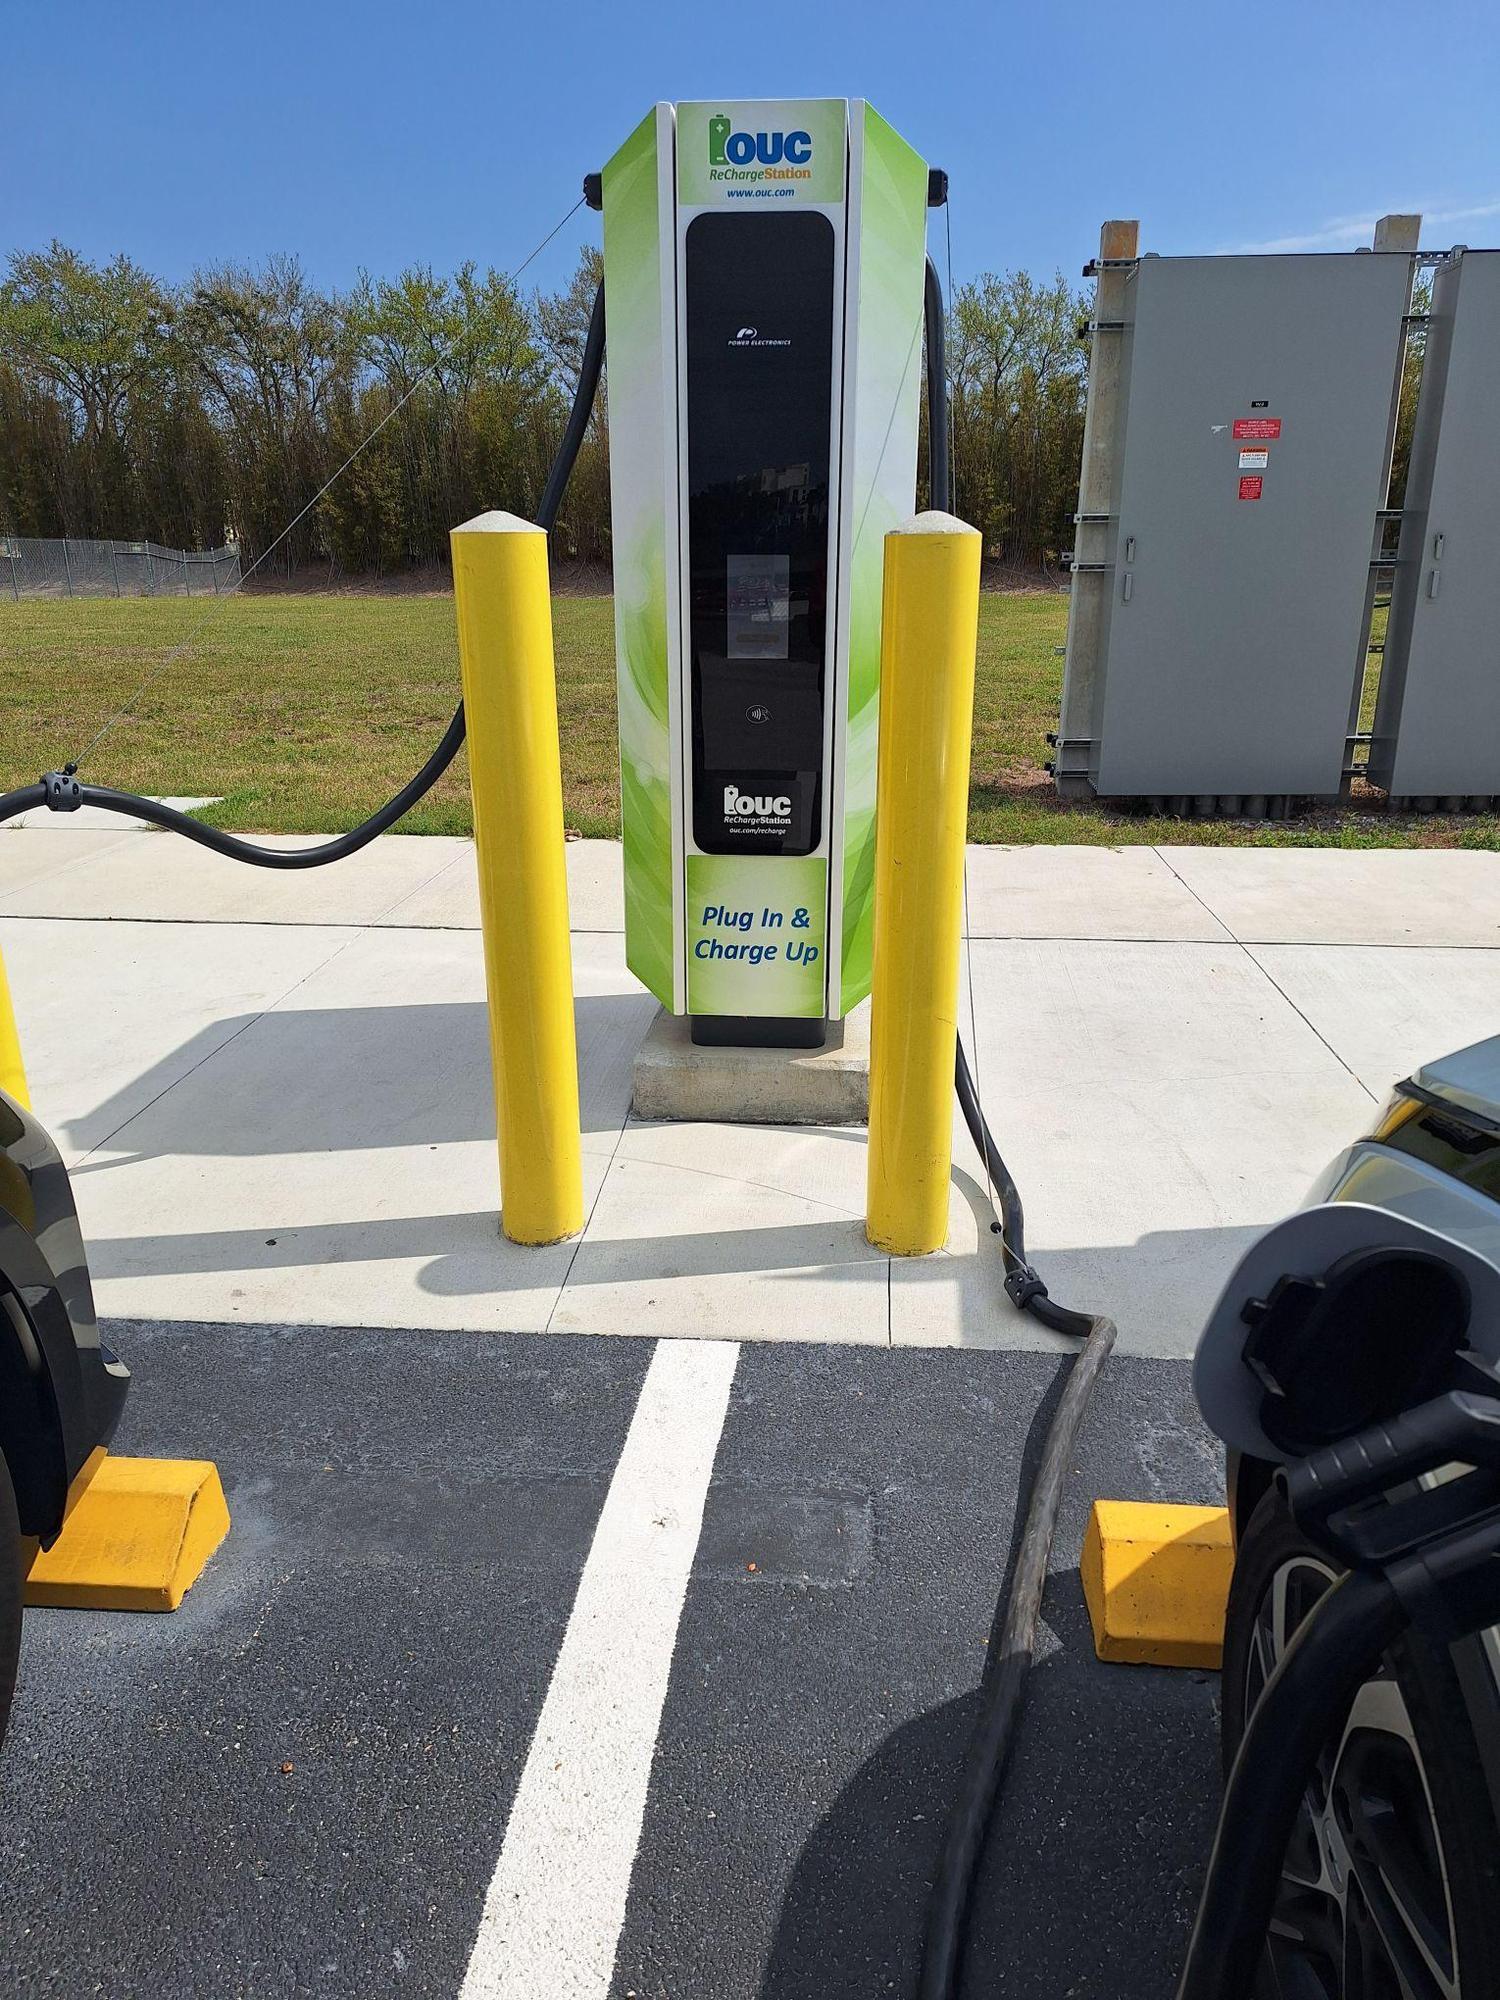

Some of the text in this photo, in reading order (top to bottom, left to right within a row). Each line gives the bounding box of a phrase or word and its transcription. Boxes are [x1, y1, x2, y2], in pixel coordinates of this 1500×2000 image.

[726, 131, 811, 165] OUC
[727, 188, 795, 198] www.ouc.com
[729, 827, 786, 835] ouc.com/recharge
[702, 906, 810, 931] Plug In &
[695, 939, 818, 966] Charge Up
